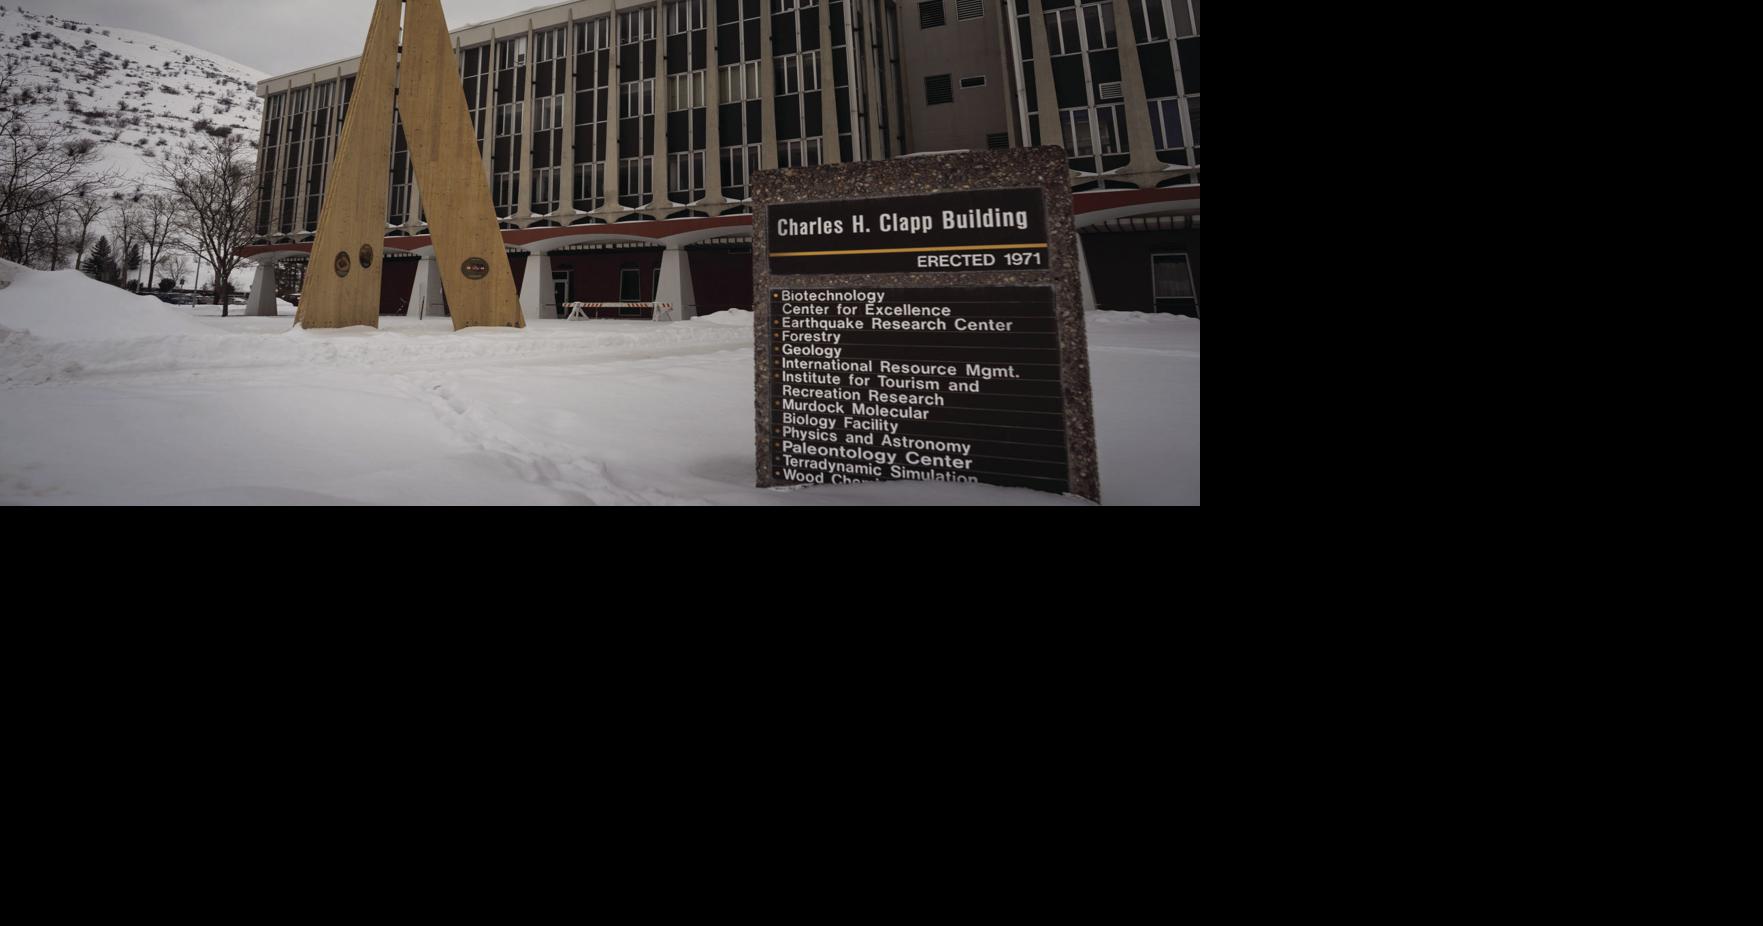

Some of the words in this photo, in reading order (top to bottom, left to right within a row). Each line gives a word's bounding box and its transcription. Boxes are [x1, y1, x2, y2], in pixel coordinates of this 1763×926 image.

[778, 217, 843, 236] Charles
[852, 215, 870, 233] H.
[880, 211, 933, 234] Clapp
[942, 208, 1028, 230] Building
[917, 254, 995, 267] ERECTED
[1005, 253, 1041, 265] 1971
[782, 289, 885, 304] Biotechnology
[782, 304, 829, 315] Center
[837, 304, 857, 315] for
[865, 304, 951, 316] Excellence
[782, 318, 864, 332] Earthquake
[872, 318, 946, 330] Research
[954, 319, 1013, 332] Center
[782, 331, 841, 344] Forestry
[782, 344, 841, 358] Geology
[782, 358, 872, 373] International
[881, 361, 957, 375] Resource
[966, 364, 1020, 380] Mgmt.
[782, 372, 841, 385] Institute
[849, 374, 870, 386] for
[878, 376, 940, 390] Tourism
[948, 379, 979, 392] and
[782, 386, 860, 400] Recreation
[869, 390, 944, 406] Research
[783, 399, 844, 414] Murdock
[852, 403, 929, 420] Molecular
[783, 413, 836, 429] Biology
[844, 417, 898, 434] Facility
[783, 426, 837, 442] Physics
[846, 431, 873, 445] and
[881, 435, 971, 455] Astronomy
[783, 441, 896, 464] Paleontology
[906, 451, 972, 470] Center
[783, 455, 882, 477] Terradynamic
[890, 465, 978, 483] Simulation
[783, 469, 824, 485] Wood
